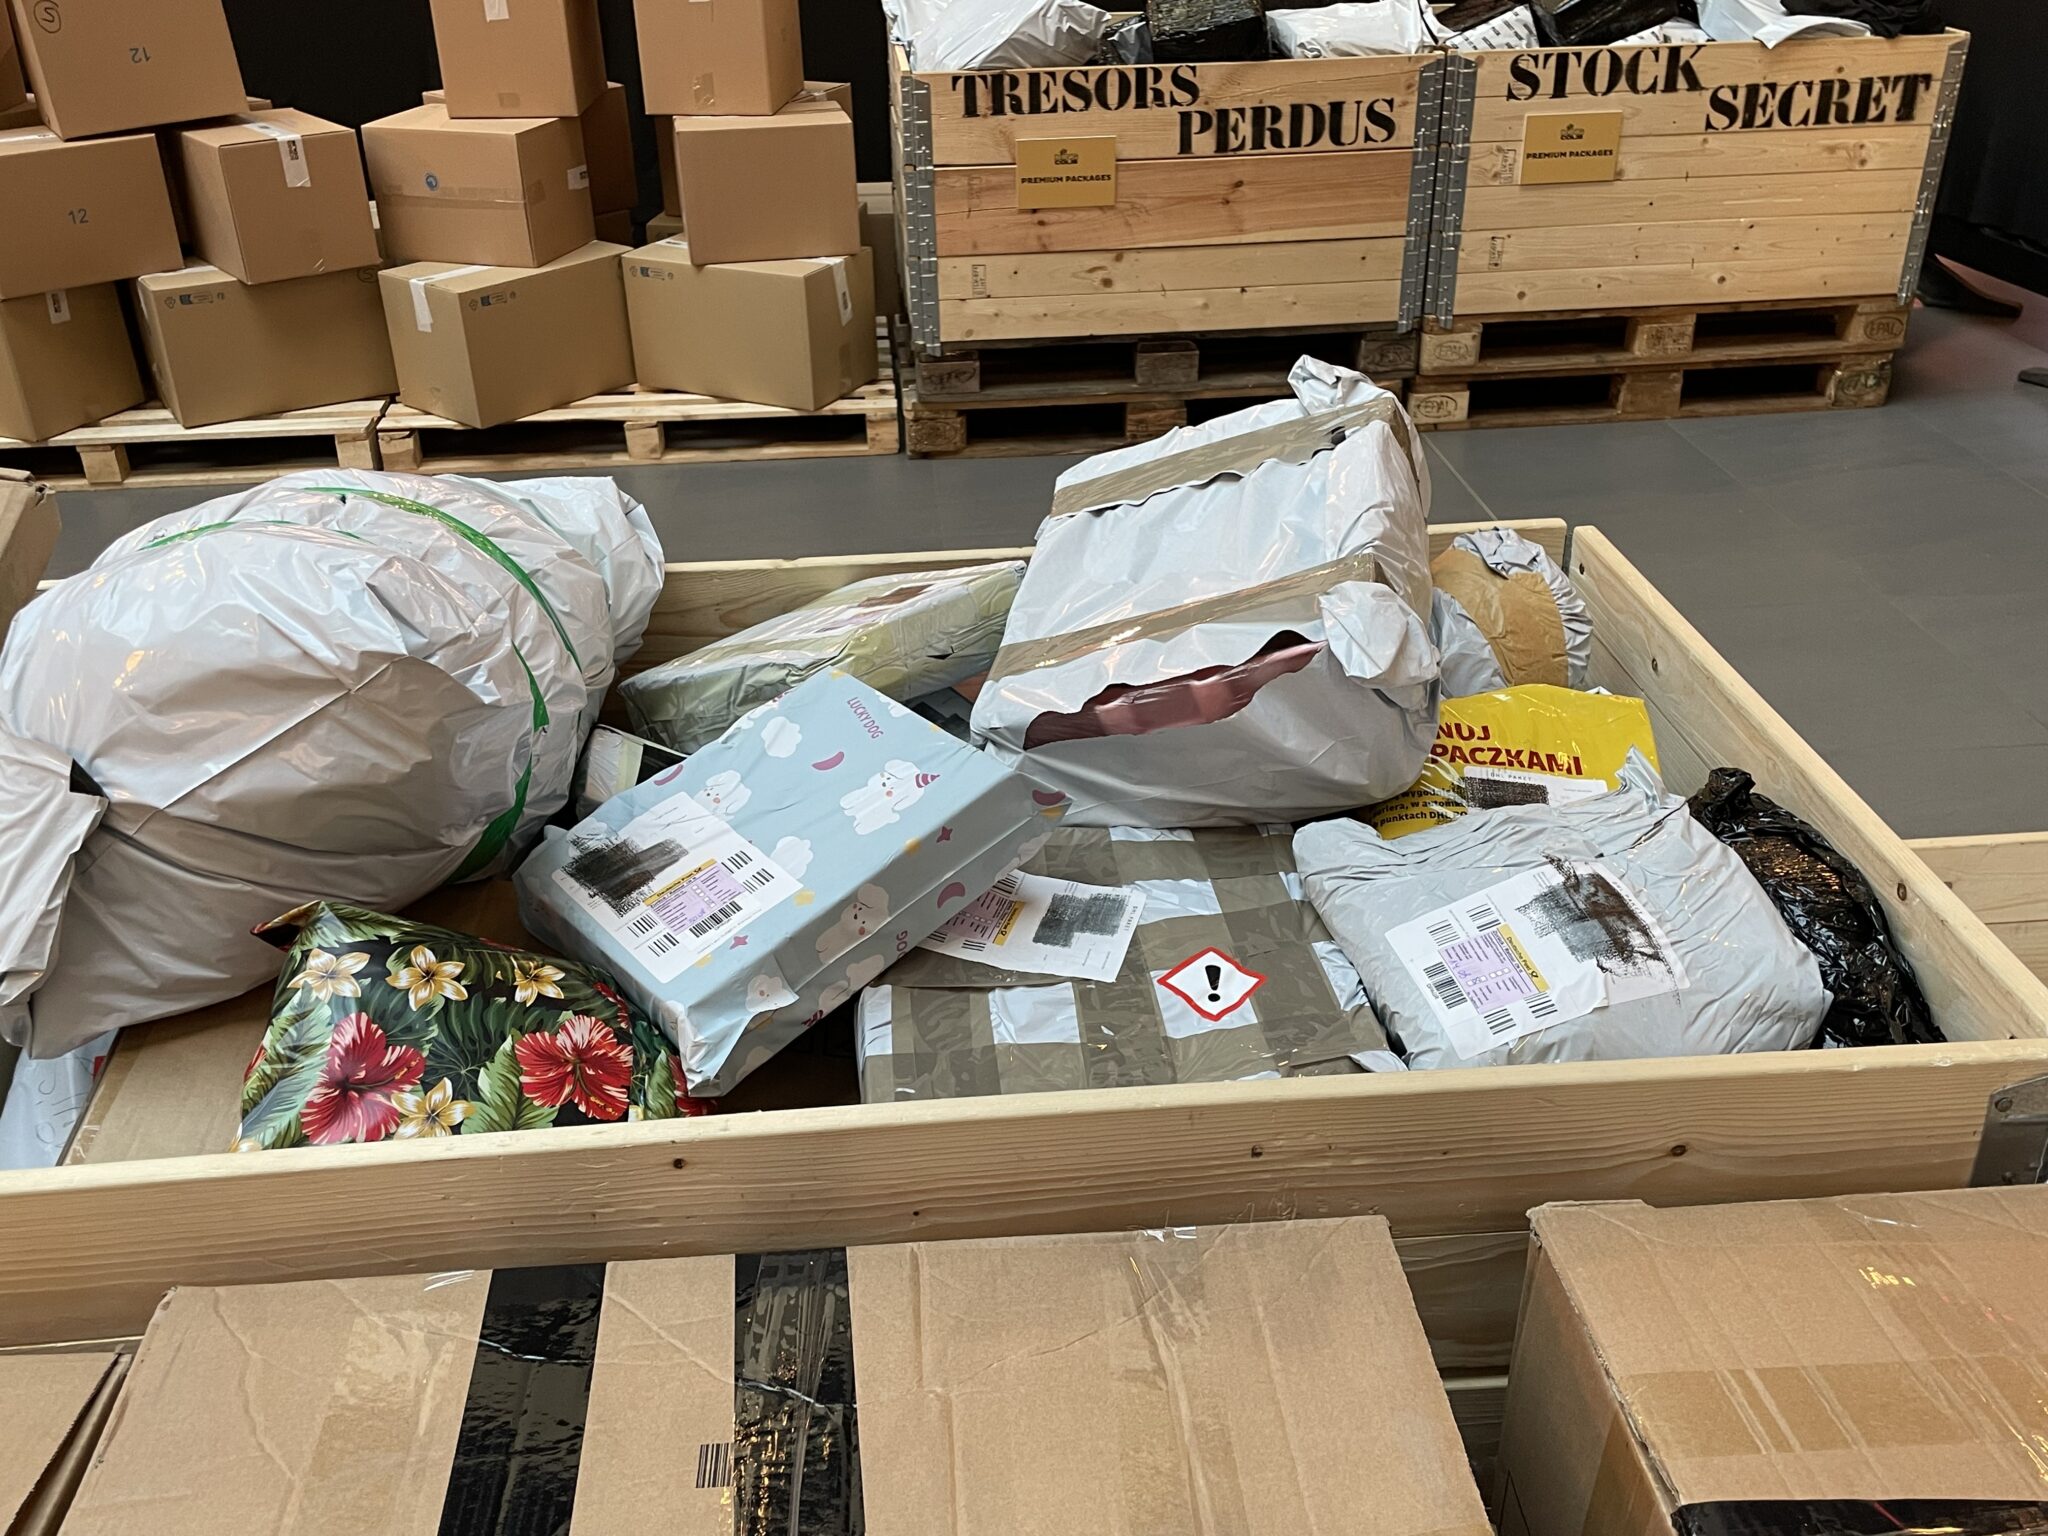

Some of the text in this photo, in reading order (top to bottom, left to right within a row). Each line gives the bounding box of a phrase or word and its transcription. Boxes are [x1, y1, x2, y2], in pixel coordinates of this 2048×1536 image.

[130, 47, 151, 63] 12
[1506, 44, 1707, 102] STOCK
[952, 65, 1200, 118] TRESORS
[1705, 74, 1932, 131] SECRET
[1178, 97, 1396, 154] PERDUS
[1526, 149, 1613, 160] PREMIUM PACKAGES
[1021, 174, 1111, 184] PREMIUM PACKAGES
[68, 208, 89, 225] 12
[847, 696, 884, 739] LUCKY DOG
[1430, 744, 1583, 775] PACZKAMI
[1379, 811, 1427, 826] punktach
